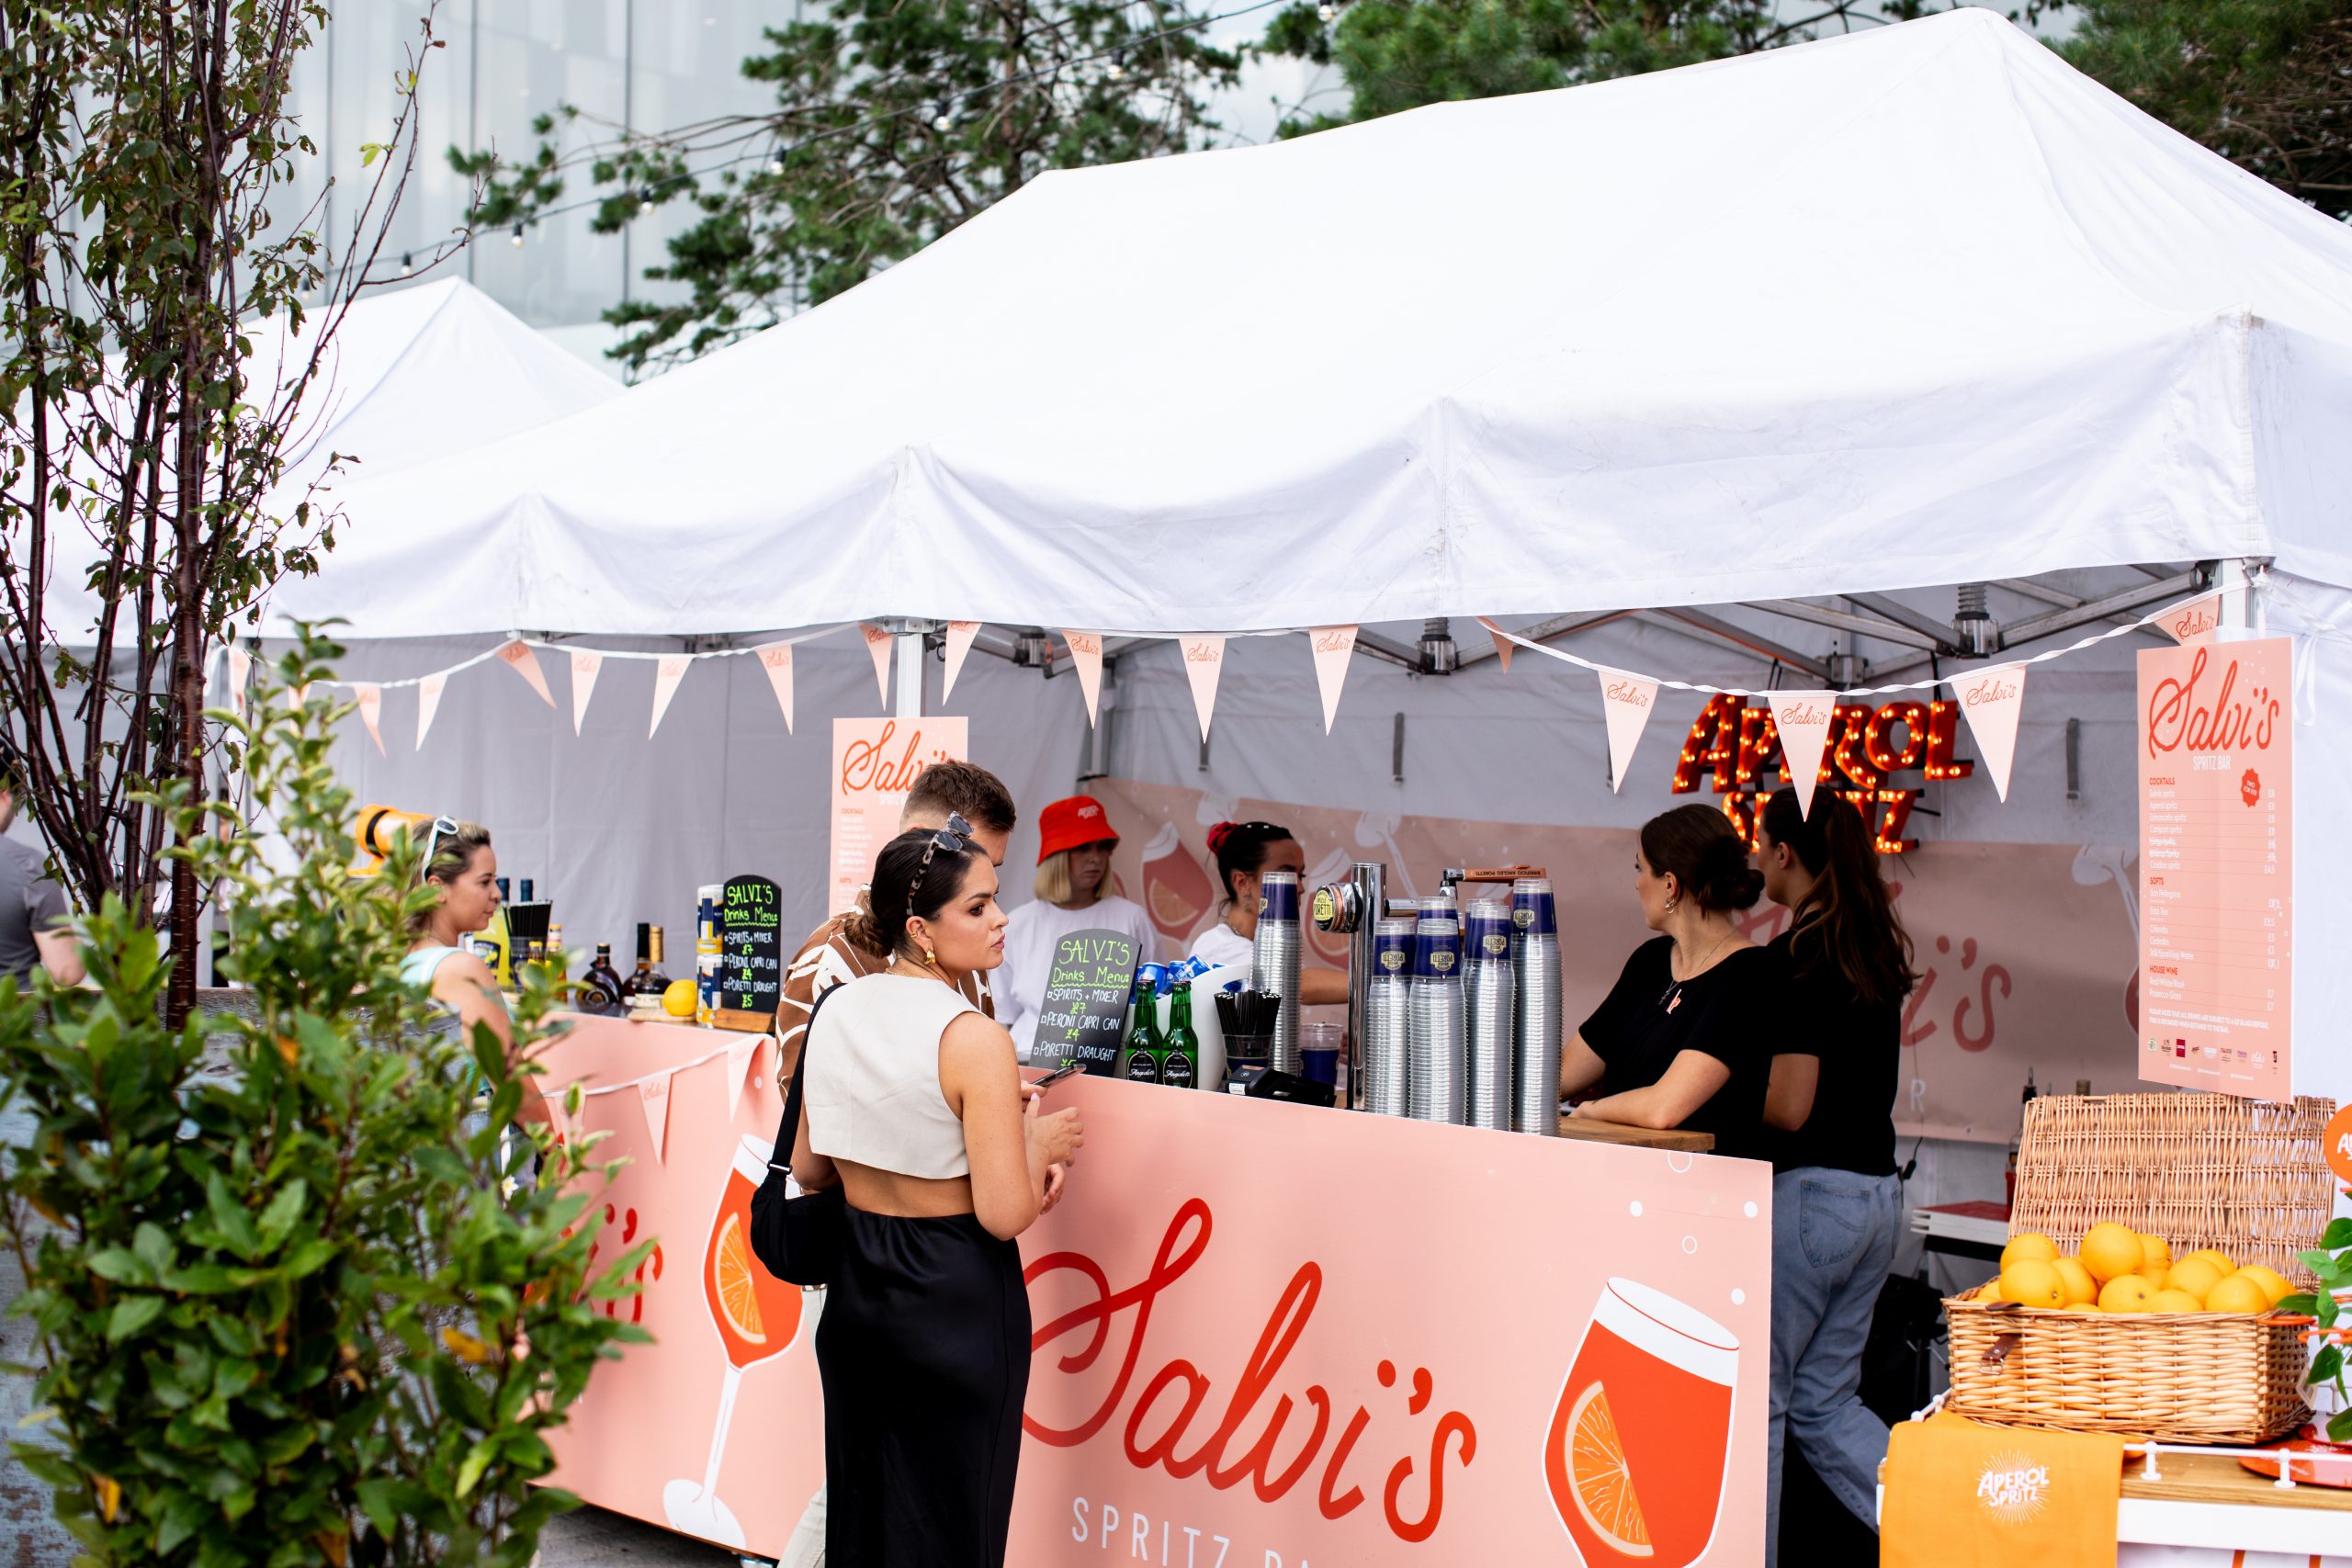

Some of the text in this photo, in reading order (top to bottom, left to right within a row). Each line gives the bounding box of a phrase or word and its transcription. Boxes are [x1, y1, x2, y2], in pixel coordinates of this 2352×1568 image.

[2177, 612, 2214, 639] Salvi's
[1188, 643, 1219, 662] Salvi's
[1317, 632, 1350, 654] Salvi's
[1607, 682, 1647, 706] Salvi's
[1966, 679, 2017, 707] Salvi's
[2149, 647, 2279, 760] Salvi's
[1781, 702, 1827, 726] Salvi's
[1672, 694, 1974, 794] APROL
[2193, 755, 2232, 771] SPRITZ BAR
[2149, 777, 2176, 785] COCKTAILS
[727, 885, 773, 907] SALVI'S
[724, 908, 750, 922] Drinks
[729, 931, 750, 945] SPIRITS
[753, 931, 773, 943] MIXER
[1058, 939, 1130, 965] SALVI'S
[765, 957, 777, 970] CAN
[2150, 964, 2165, 974] HOUSE
[728, 976, 777, 993] PORETTI DRAUGHT
[1052, 966, 1085, 983] Drinks
[741, 994, 753, 1009] £5
[1051, 988, 1083, 1001] SPIRITS
[1091, 989, 1119, 1004] MIXER
[1069, 1001, 1087, 1014] £7
[1046, 1011, 1121, 1031] PERONI CAPRI CAN
[1065, 1028, 1080, 1042] £4
[1039, 1041, 1117, 1062] PORETTI DRAUGHT
[1022, 1197, 1477, 1542] Salvi's
[1977, 1466, 2050, 1497] APEROL
[1988, 1486, 2038, 1507] SPRITZ
[1072, 1496, 1230, 1568] SPRITZ
